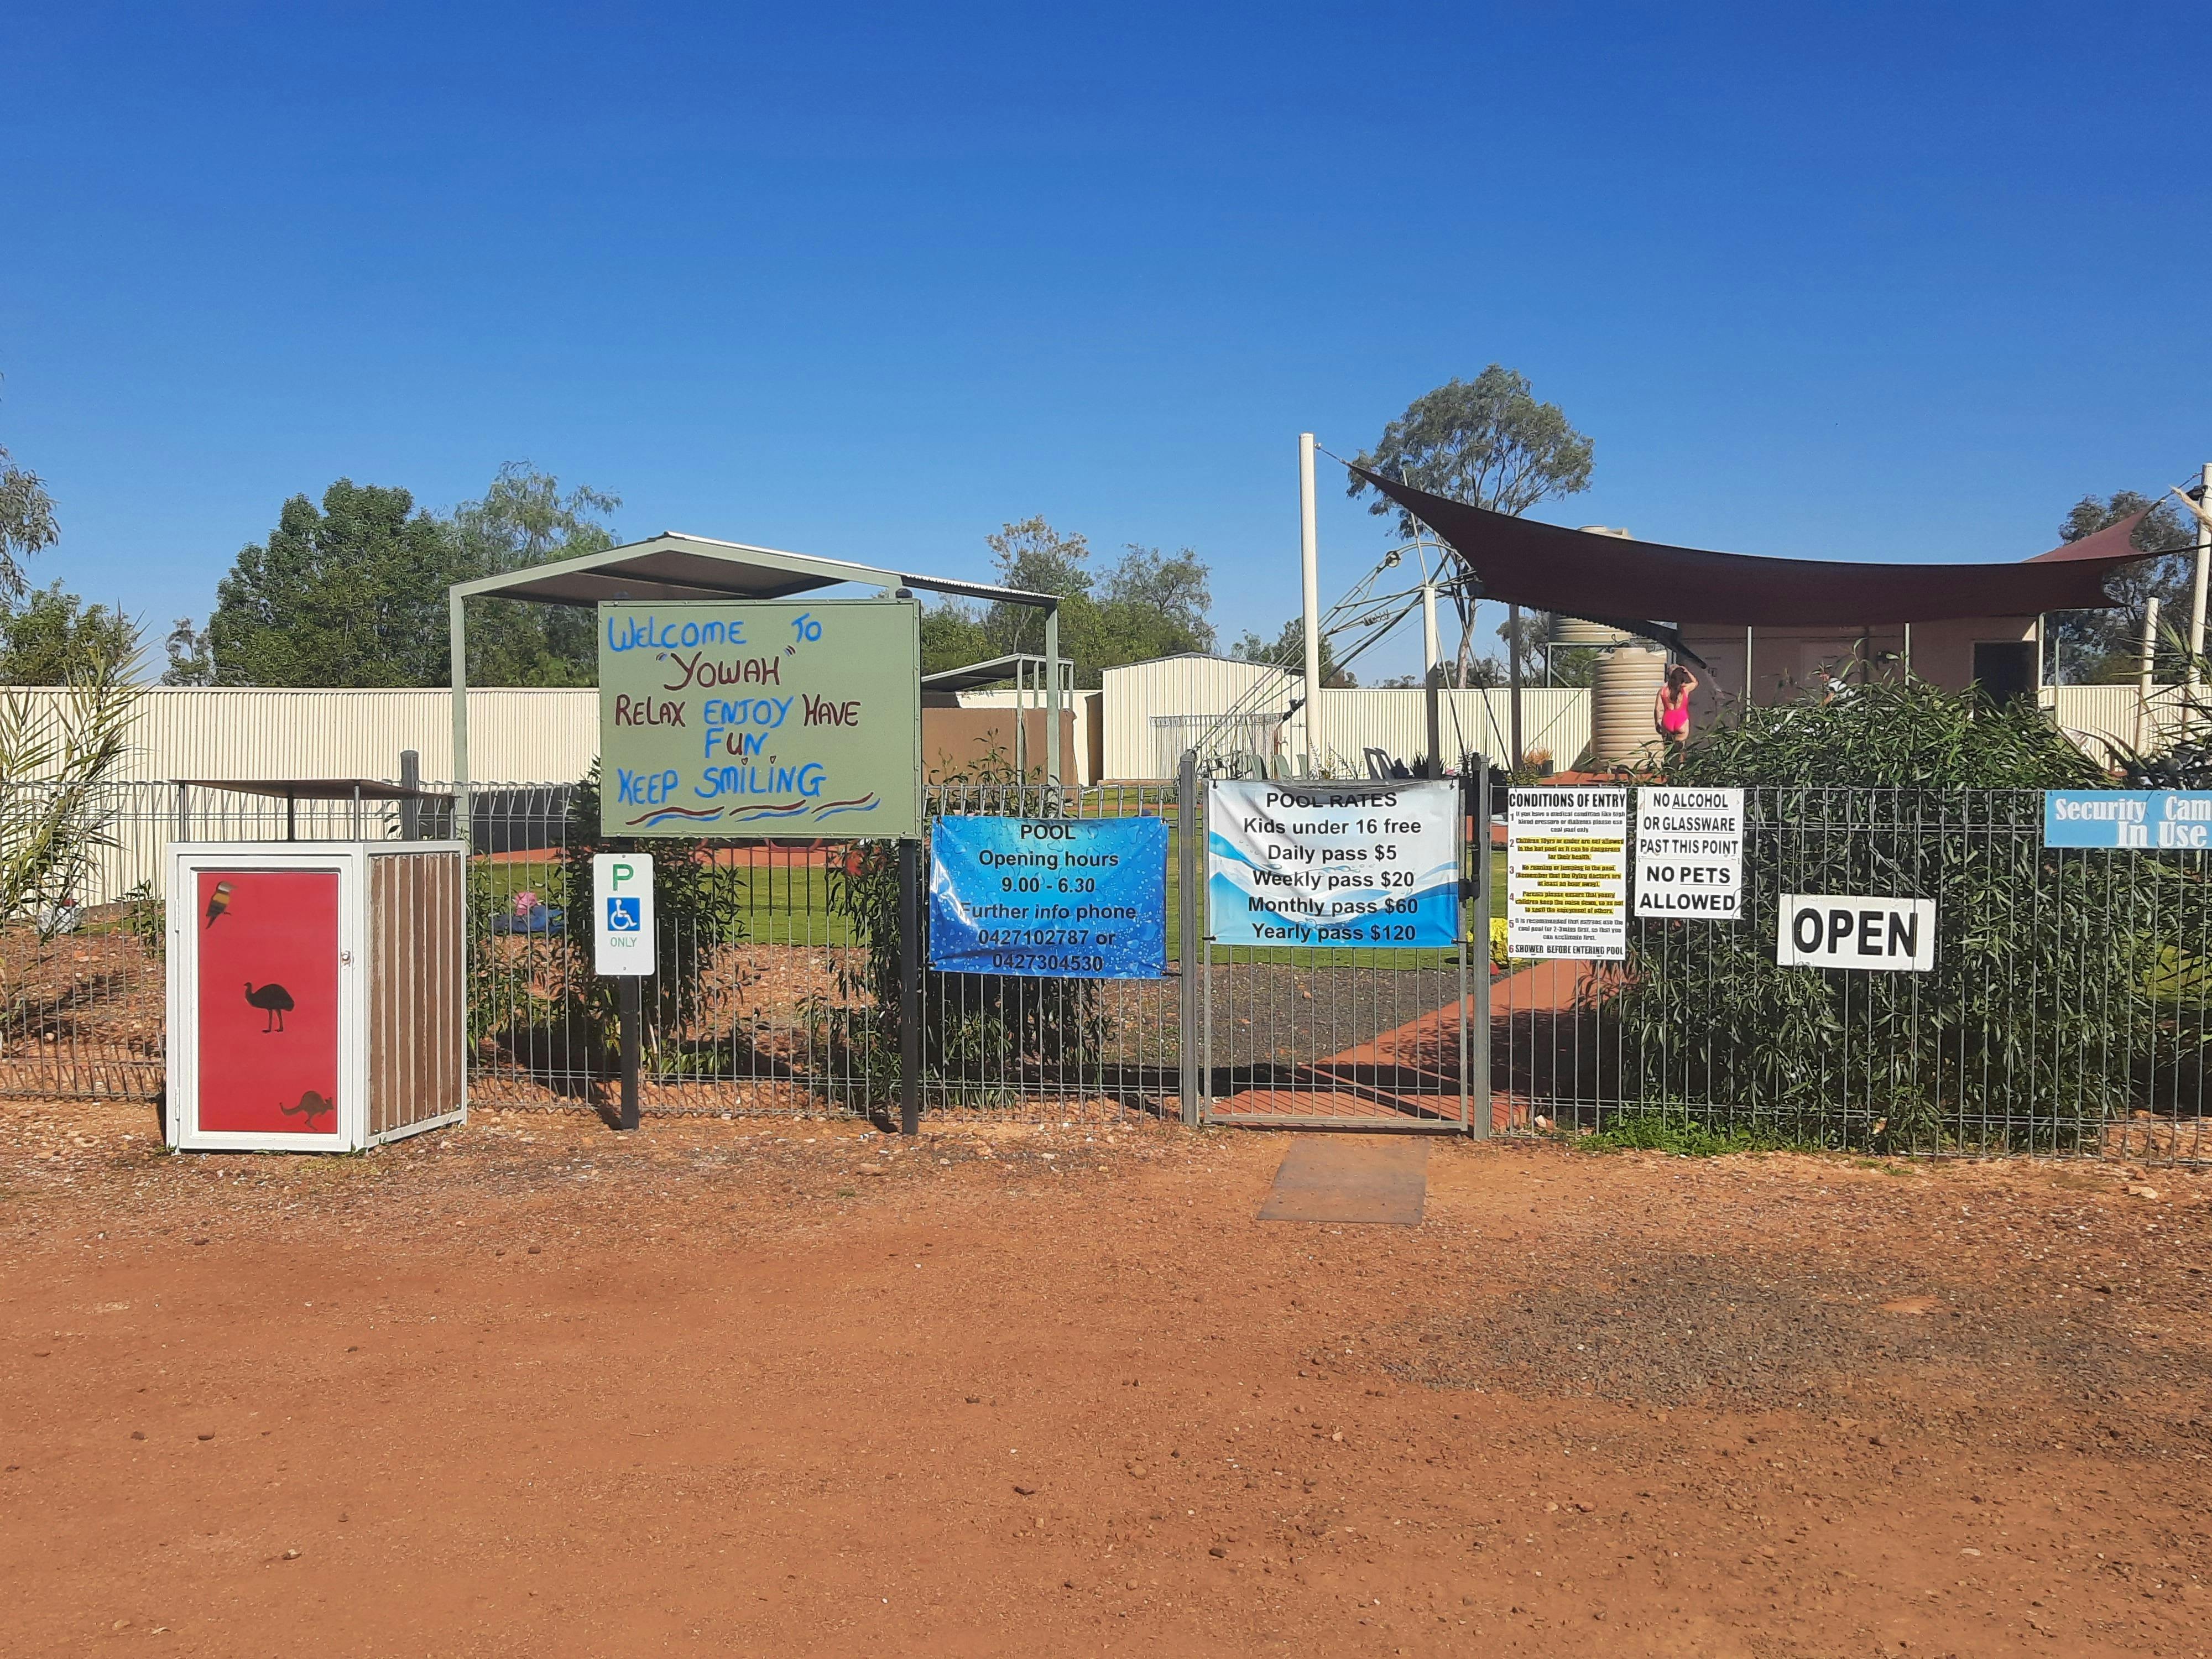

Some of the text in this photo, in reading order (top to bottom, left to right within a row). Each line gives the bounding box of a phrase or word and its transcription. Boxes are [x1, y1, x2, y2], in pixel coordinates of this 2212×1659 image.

[791, 613, 822, 642] TO
[703, 696, 794, 728] ENJOY
[802, 693, 861, 727] HAVE
[617, 768, 679, 806] KEEP
[1267, 792, 1397, 808] POOL RATES
[1509, 794, 1625, 807] CONDITIONS OF ENTRY
[1653, 793, 1729, 808] NO ALCOHOL
[2056, 799, 2147, 823] Security
[1021, 825, 1076, 840] POOL
[1244, 817, 1422, 834] Kids under 16 free
[1644, 816, 1735, 831] OR GLASSWARE
[1510, 839, 1514, 847] 2
[2117, 821, 2207, 847] In Use
[1268, 845, 1397, 864] Daily pass $5
[1640, 839, 1738, 854] PAST THIS POINT
[979, 850, 1119, 869] Opening hours
[613, 864, 634, 891] P
[1254, 870, 1414, 890] Weekly pass $20
[1647, 867, 1730, 884] NO PETS
[1001, 877, 1040, 893] 9.00
[1058, 878, 1095, 893] 6.30
[1248, 897, 1418, 917] Monthly pass $60
[1639, 893, 1735, 910] ALLOWED
[960, 902, 1136, 922] Further info phone
[979, 930, 1116, 945] 0427102787 or
[1252, 924, 1416, 943] Yearly pass $120
[1794, 908, 1918, 957] OPEN
[611, 937, 637, 947] ONLY
[1515, 945, 1543, 953] SHOWER
[1547, 945, 1571, 953] BEFORE
[1573, 946, 1604, 954] ENTERING
[1606, 946, 1623, 954] POOL
[993, 953, 1103, 972] 0427304530
